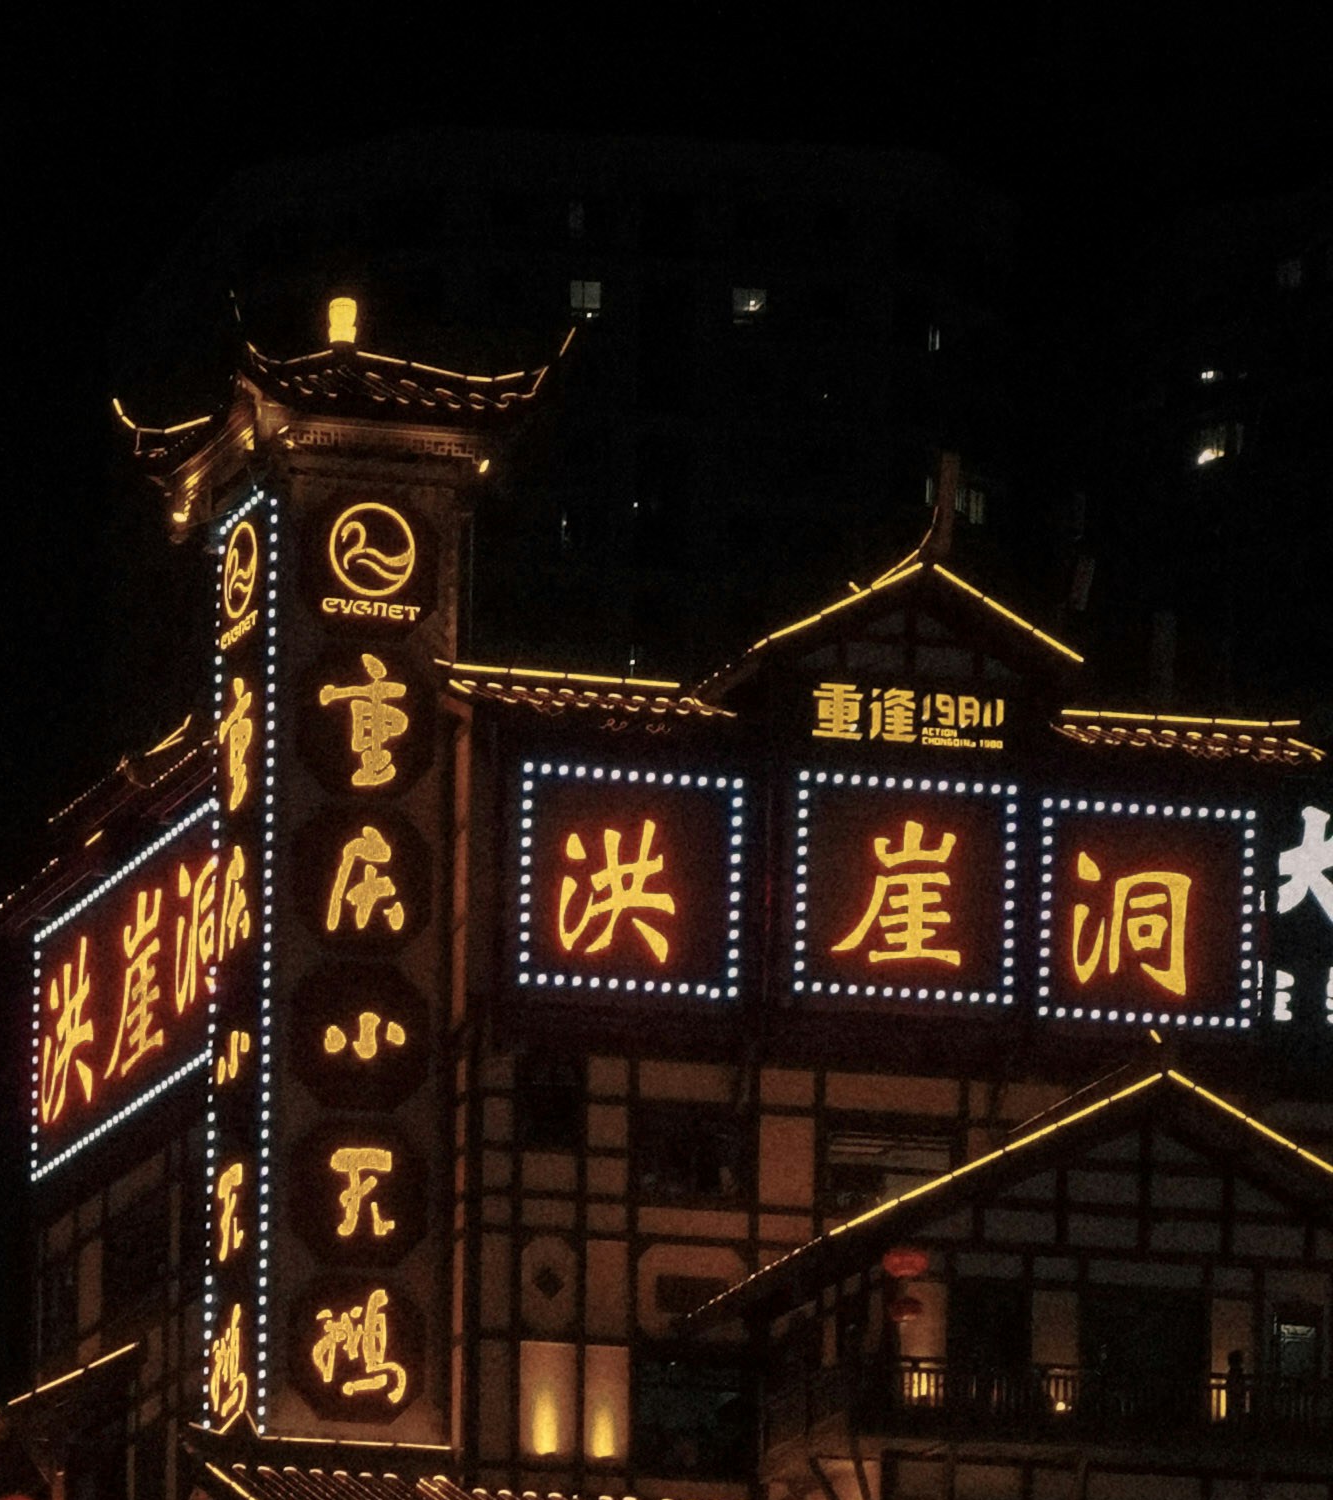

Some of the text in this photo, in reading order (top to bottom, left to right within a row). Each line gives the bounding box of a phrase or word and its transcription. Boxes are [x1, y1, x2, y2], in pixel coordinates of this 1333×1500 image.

[322, 597, 421, 621] CYGNET
[41, 856, 215, 1124] 洪崖洞
[559, 818, 1193, 996] 洪崖洞
